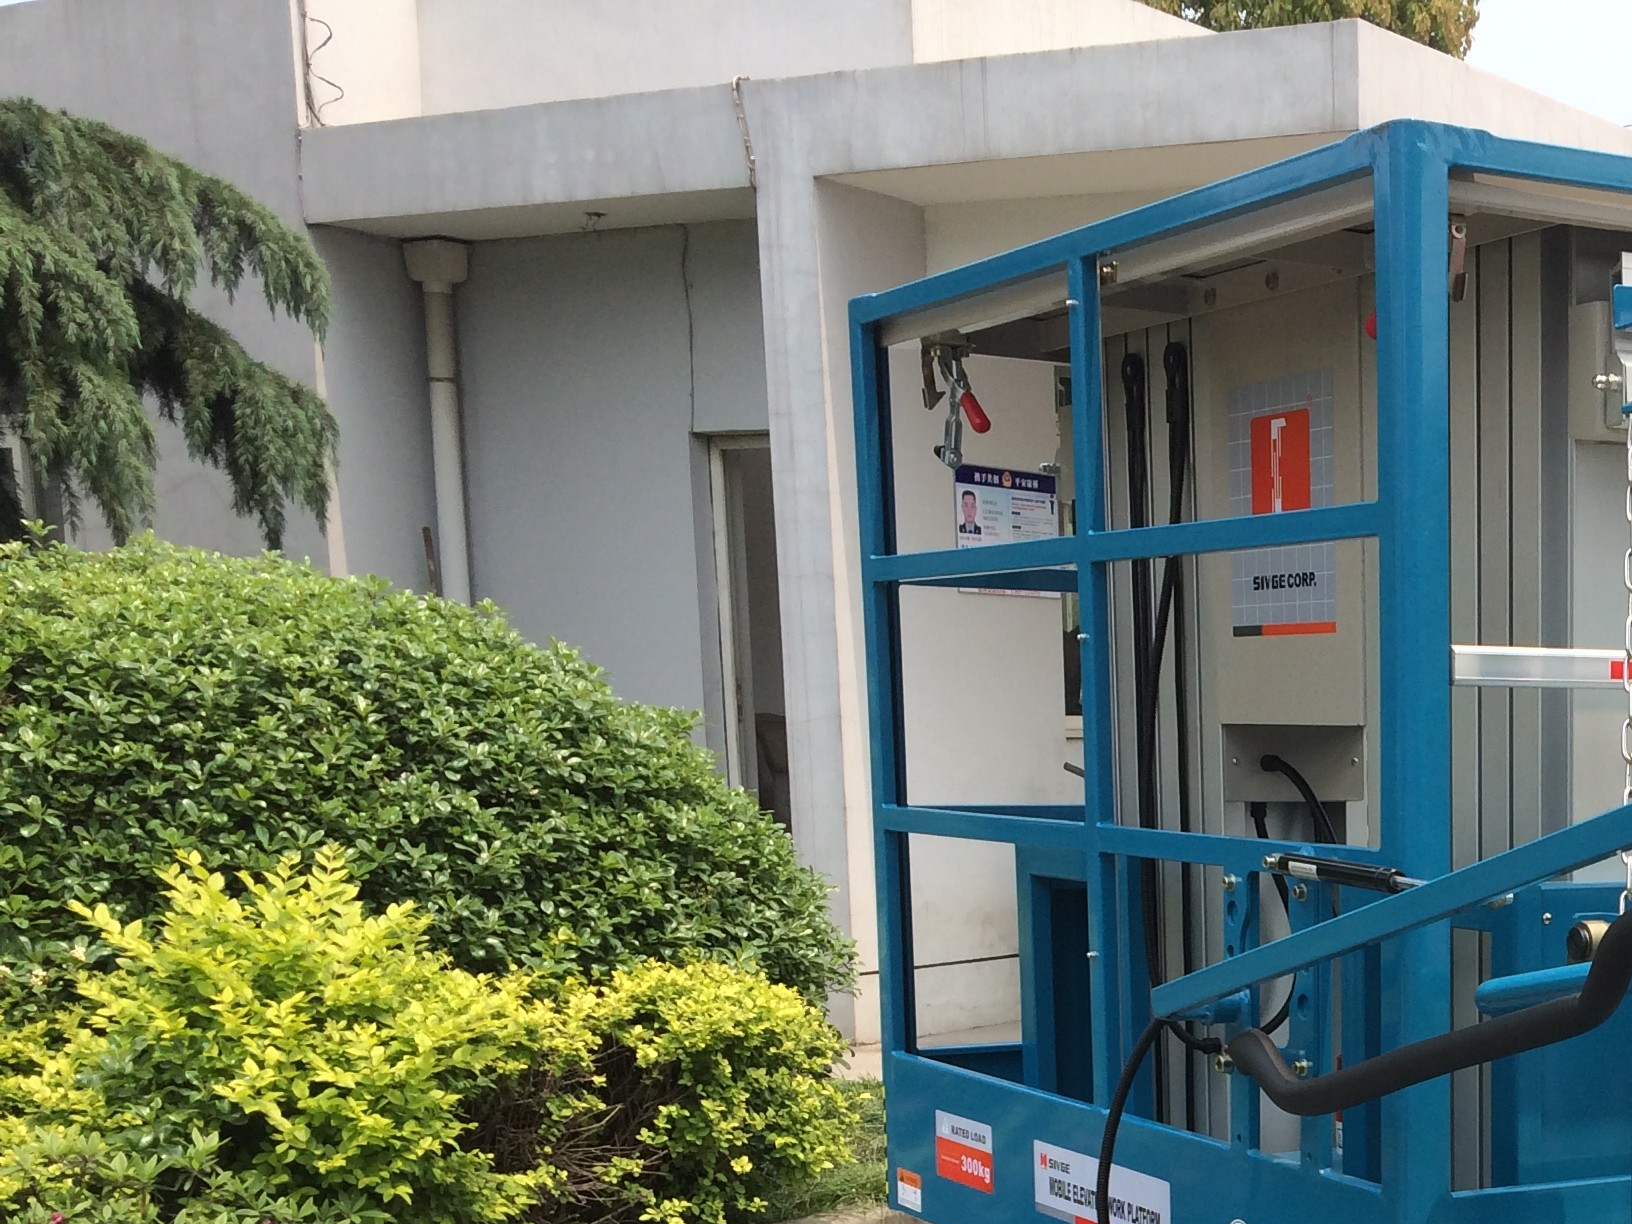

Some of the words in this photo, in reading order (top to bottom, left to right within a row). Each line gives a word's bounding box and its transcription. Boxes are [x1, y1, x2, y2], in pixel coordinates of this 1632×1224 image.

[1253, 574, 1286, 591] SIVGE
[1287, 571, 1317, 589] CORP.
[951, 1124, 970, 1140] RATED
[970, 1130, 987, 1145] LOAD
[960, 1154, 991, 1184] 300kg
[1049, 1176, 1072, 1202] MOBILE
